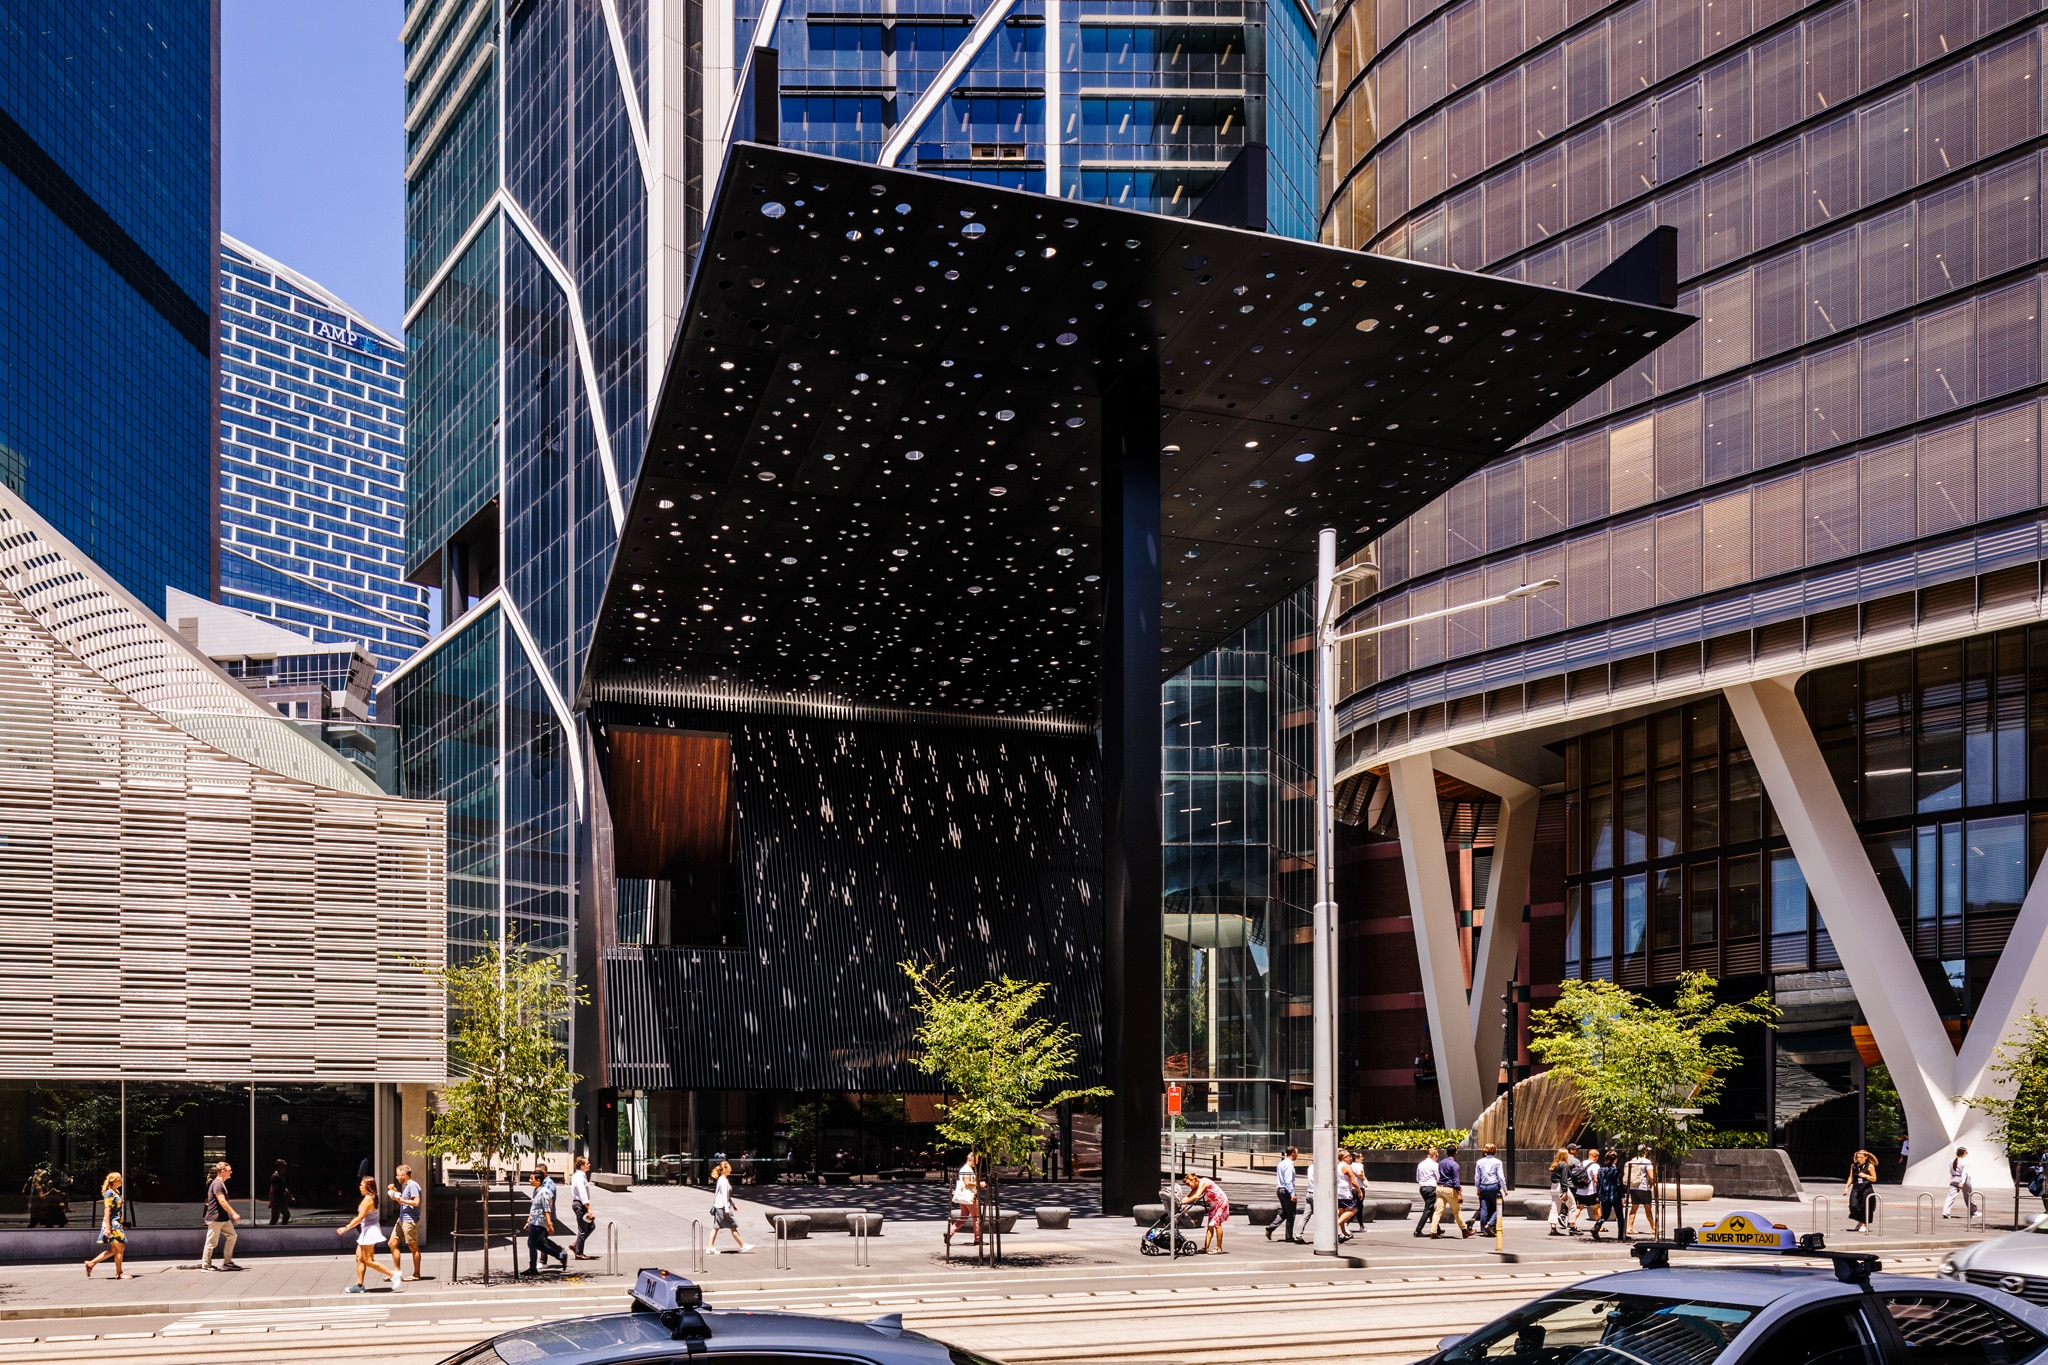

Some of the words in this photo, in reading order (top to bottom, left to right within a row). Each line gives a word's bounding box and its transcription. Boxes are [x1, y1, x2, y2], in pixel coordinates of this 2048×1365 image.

[317, 322, 357, 346] AMP
[1706, 1233, 1734, 1243] SILVER
[1735, 1234, 1753, 1243] TOP
[1753, 1234, 1774, 1244] TAXI
[645, 1278, 657, 1299] TAXI
